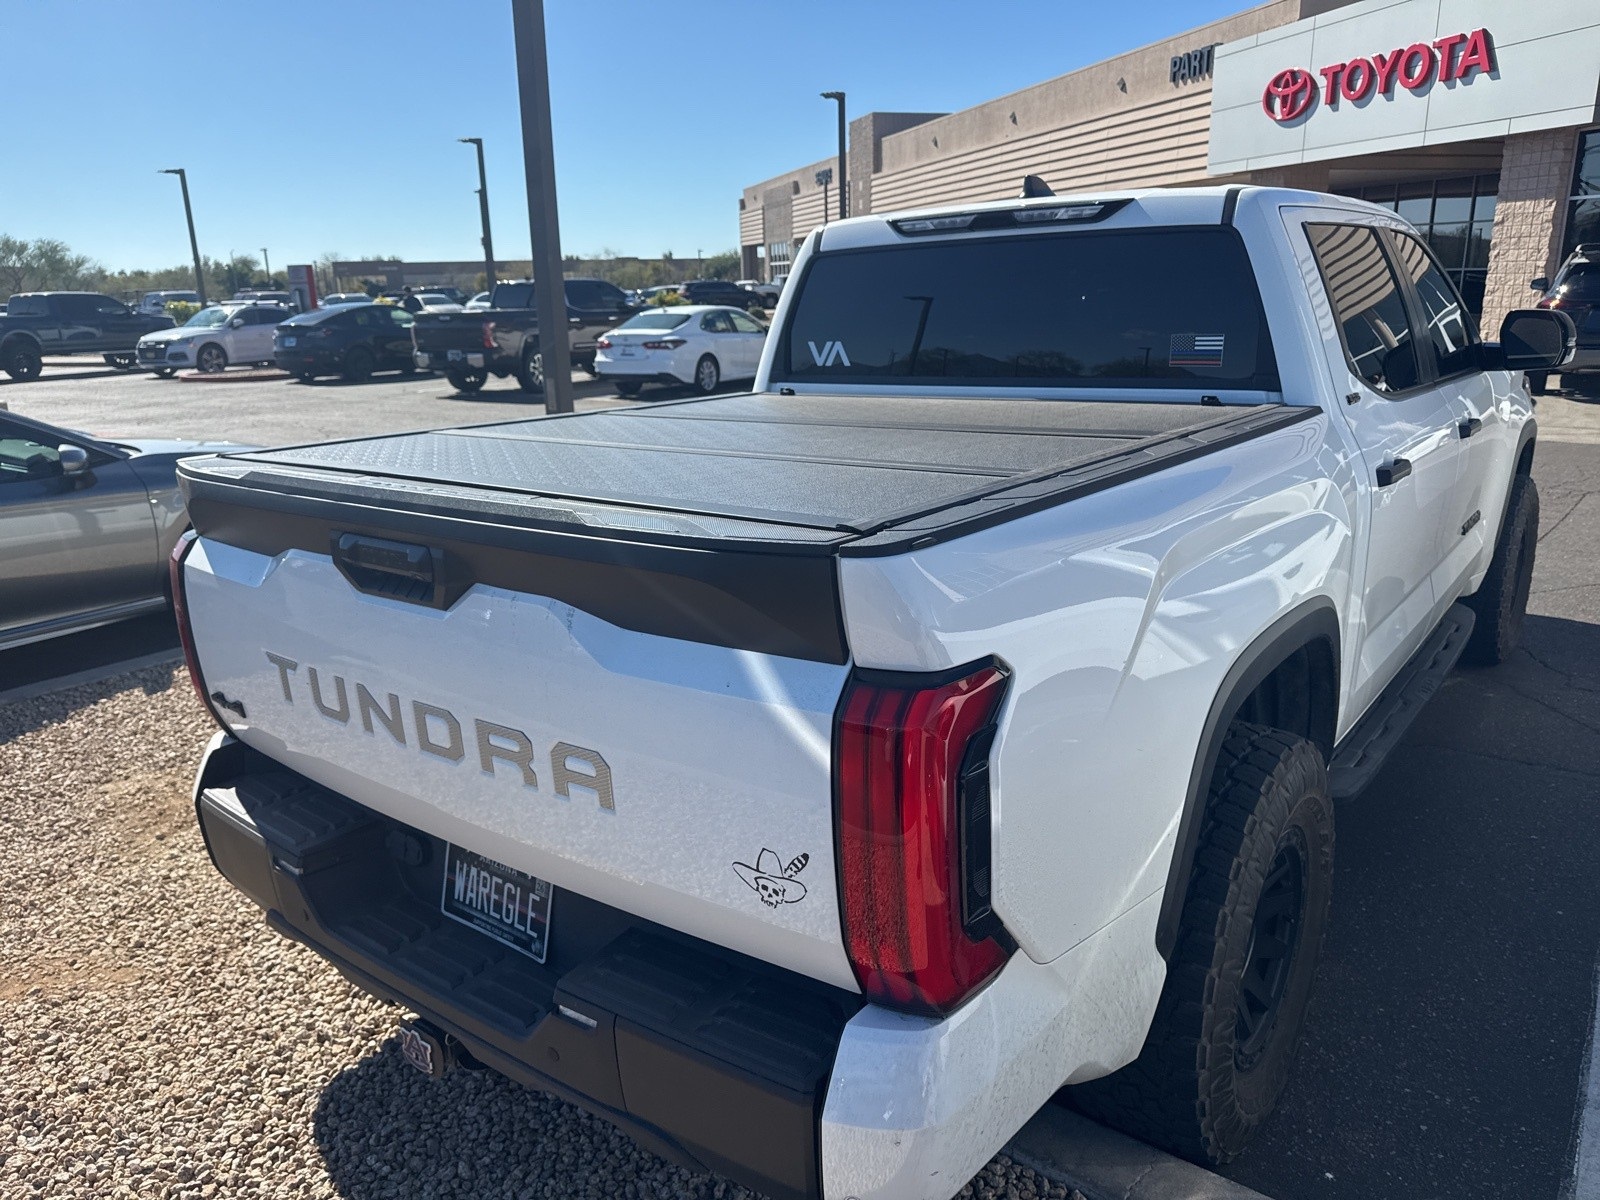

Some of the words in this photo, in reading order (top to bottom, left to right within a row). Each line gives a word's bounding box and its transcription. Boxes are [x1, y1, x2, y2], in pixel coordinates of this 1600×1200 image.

[1170, 44, 1214, 83] PART
[1320, 28, 1494, 106] TOYOTA
[808, 340, 851, 367] VA
[265, 651, 616, 813] TUNDRA
[454, 860, 540, 939] WAREGLE
